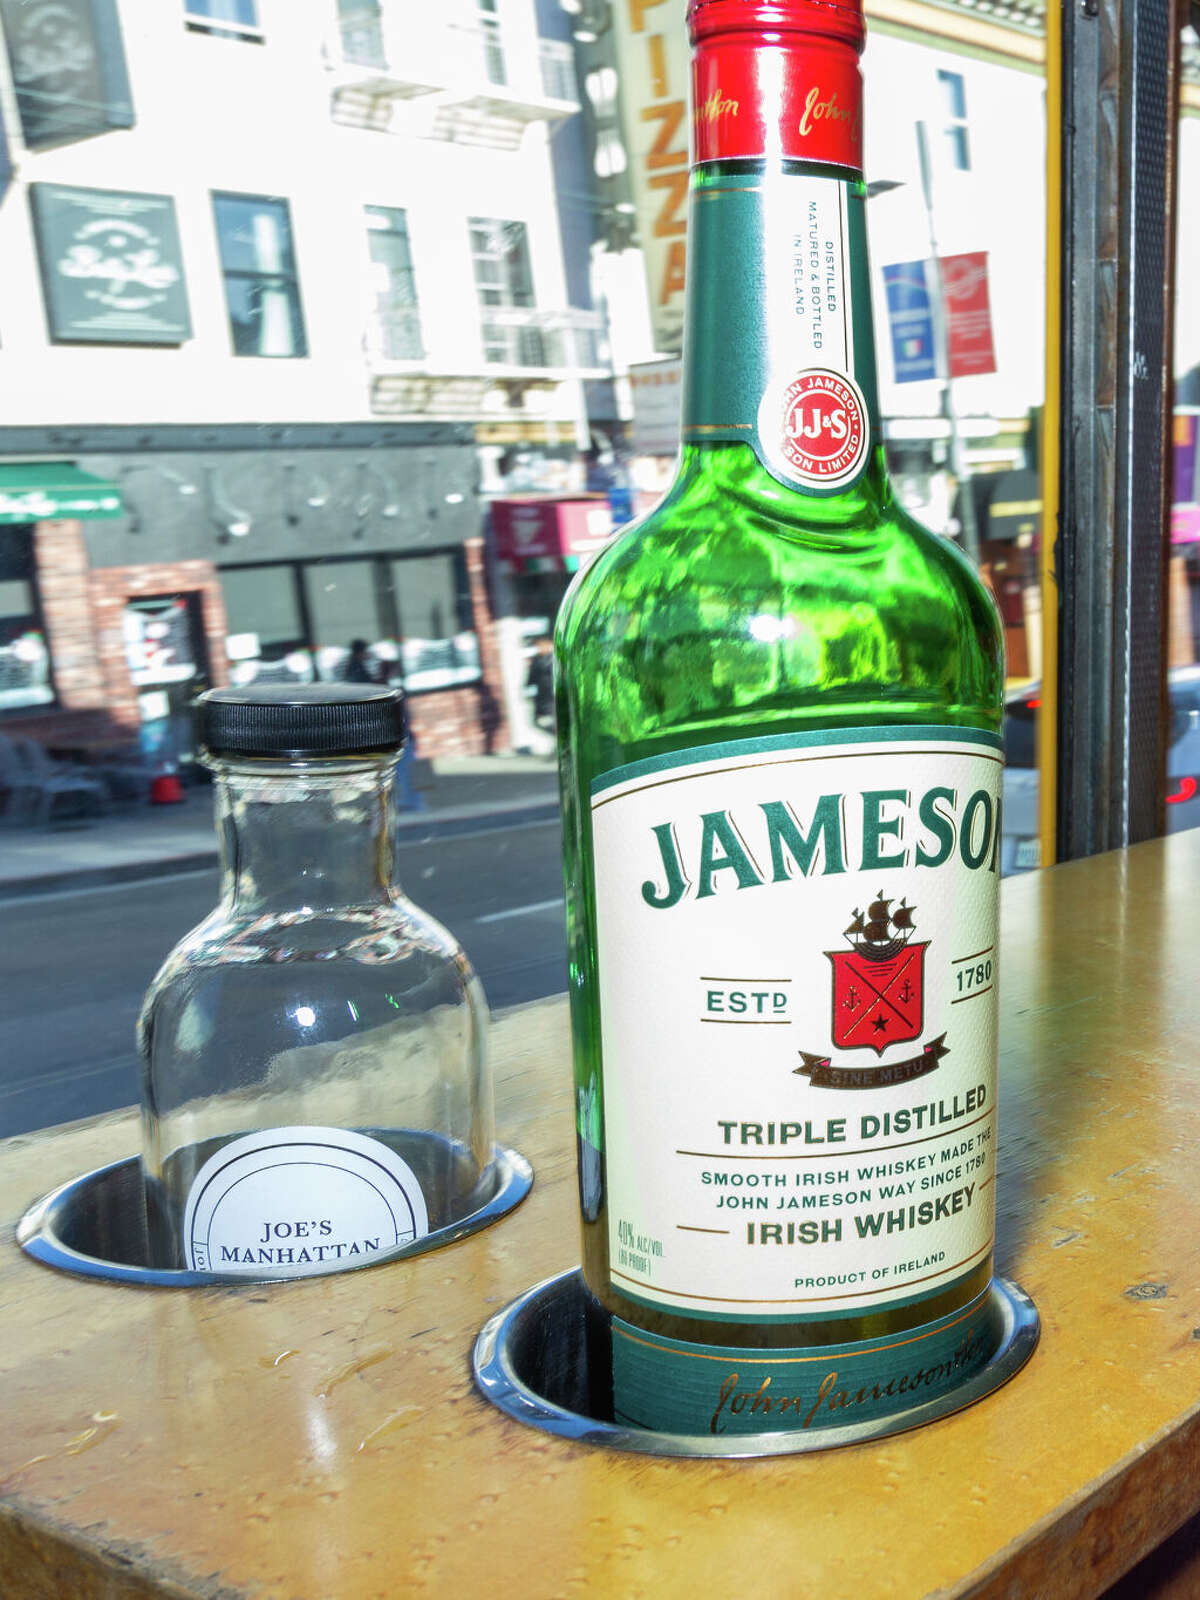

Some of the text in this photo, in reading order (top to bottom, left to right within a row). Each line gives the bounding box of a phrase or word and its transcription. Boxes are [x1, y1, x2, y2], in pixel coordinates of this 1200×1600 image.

[793, 233, 805, 316] IN IRELAND
[808, 200, 823, 350] MATURED & BOTTLED
[825, 240, 837, 313] DISTILLED
[785, 408, 847, 440] JJ&S
[807, 377, 859, 421] JAMESON
[818, 434, 859, 472] LIMITED
[955, 962, 993, 992] 1780
[830, 1060, 924, 1085] SINE METU
[717, 1083, 987, 1145] TRIPLE DISTILLED
[701, 1126, 991, 1187] SMOOTH IRISH WHISKEY MADE THE
[716, 1151, 986, 1210] JOHN JAMESON WAY SINCE 1780
[260, 1219, 332, 1243] JOE'S
[746, 1182, 976, 1246] IRISH WHISKEY
[220, 1237, 382, 1264] MANHATTAN
[794, 1251, 946, 1289] PRODUCT OF IRELAND
[710, 1372, 801, 1434] John
